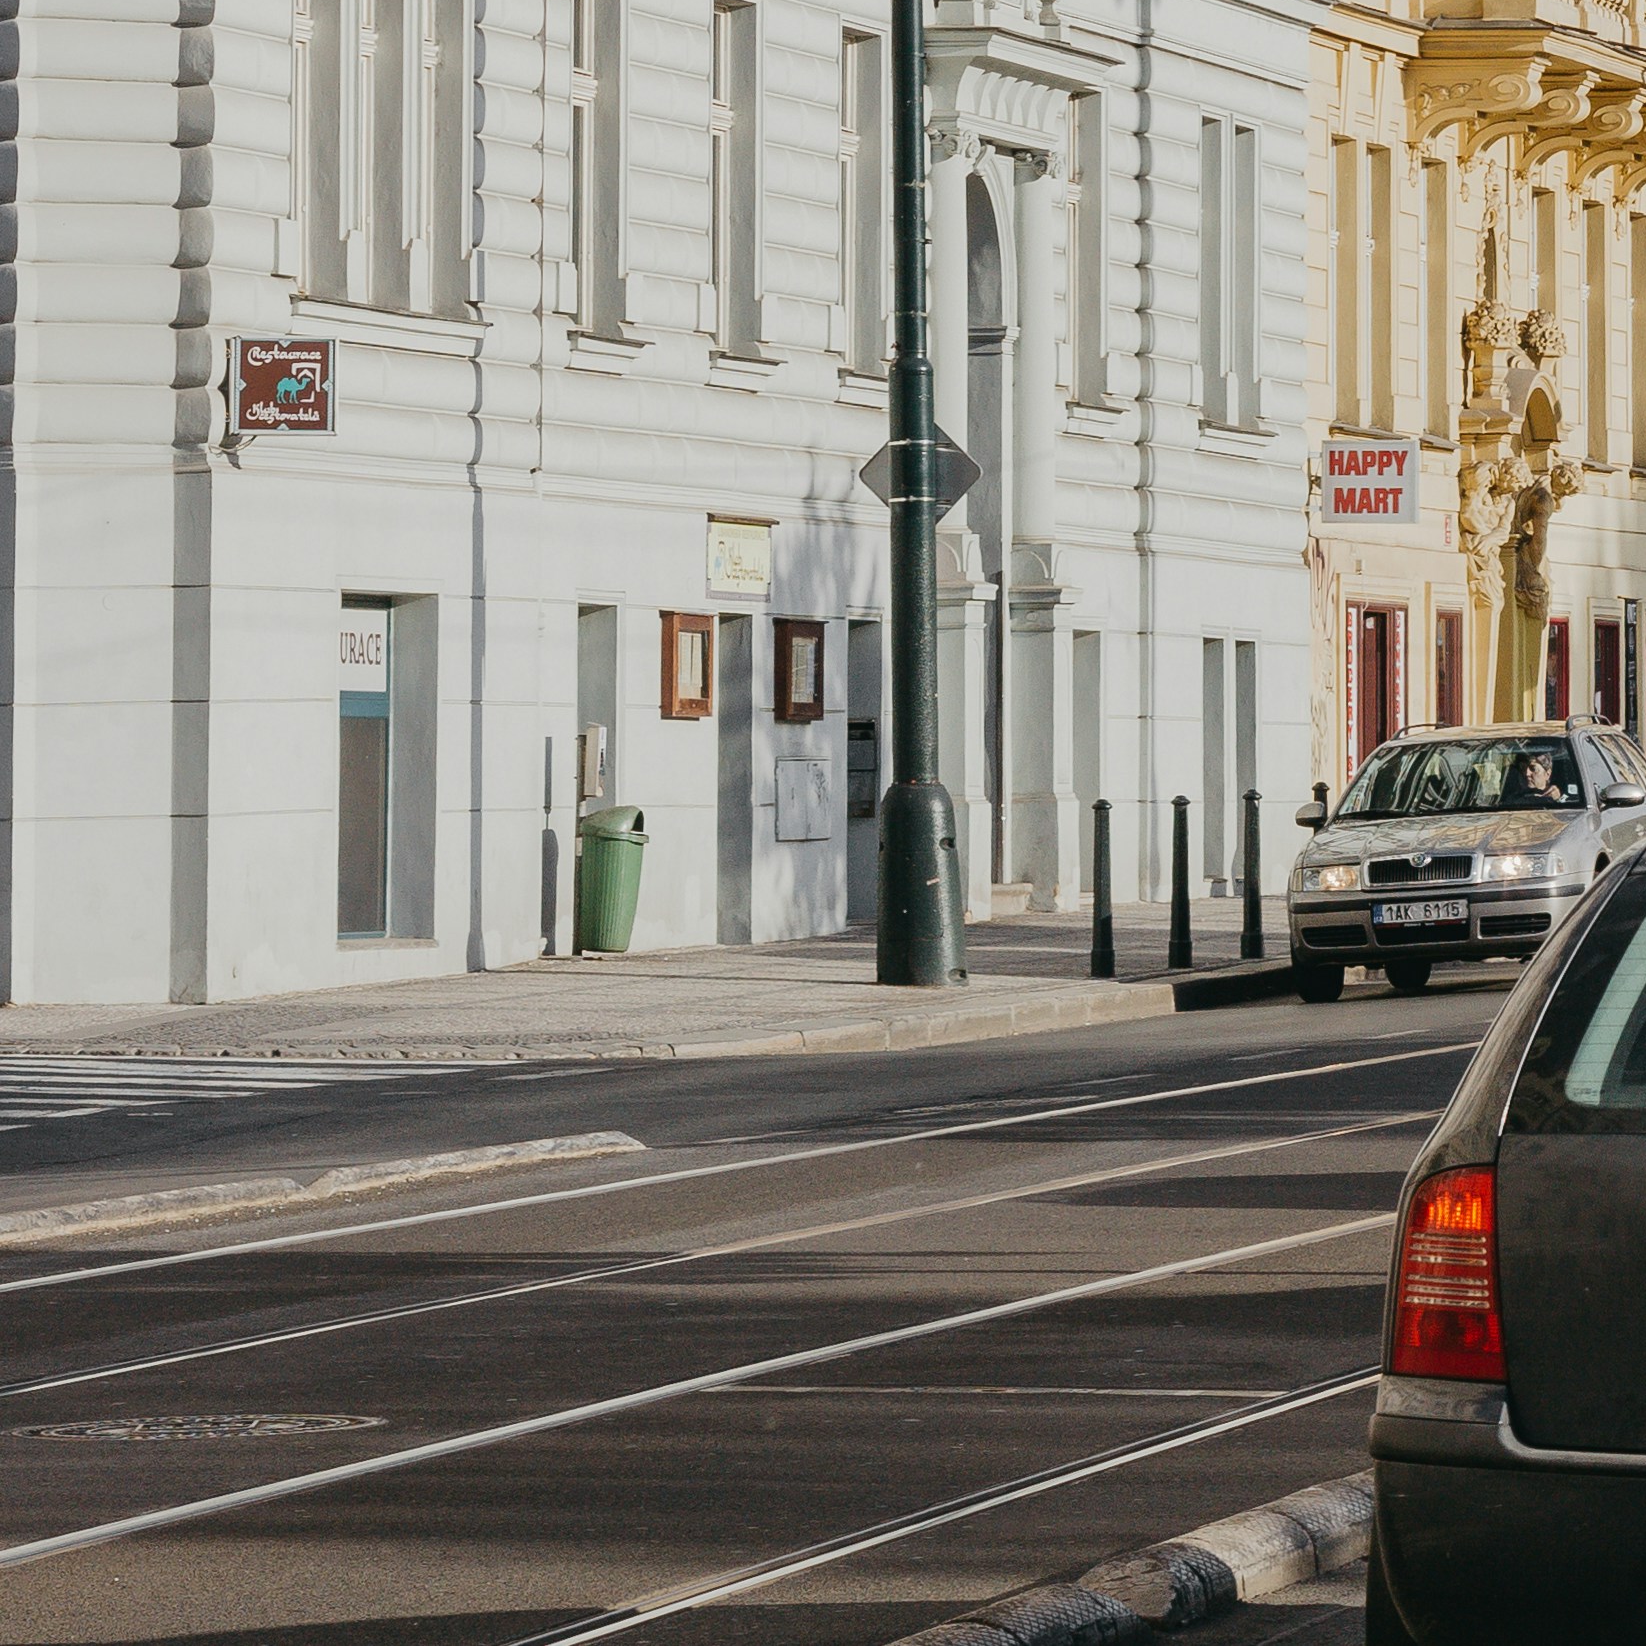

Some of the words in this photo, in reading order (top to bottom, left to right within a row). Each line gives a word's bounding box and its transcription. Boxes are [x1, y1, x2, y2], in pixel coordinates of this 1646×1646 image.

[247, 344, 321, 366] Restaurace
[1329, 450, 1408, 476] HAPPY
[1334, 487, 1403, 514] MART
[340, 632, 382, 665] URACE
[1386, 904, 1414, 920] 1AK
[1424, 901, 1460, 918] 6115
